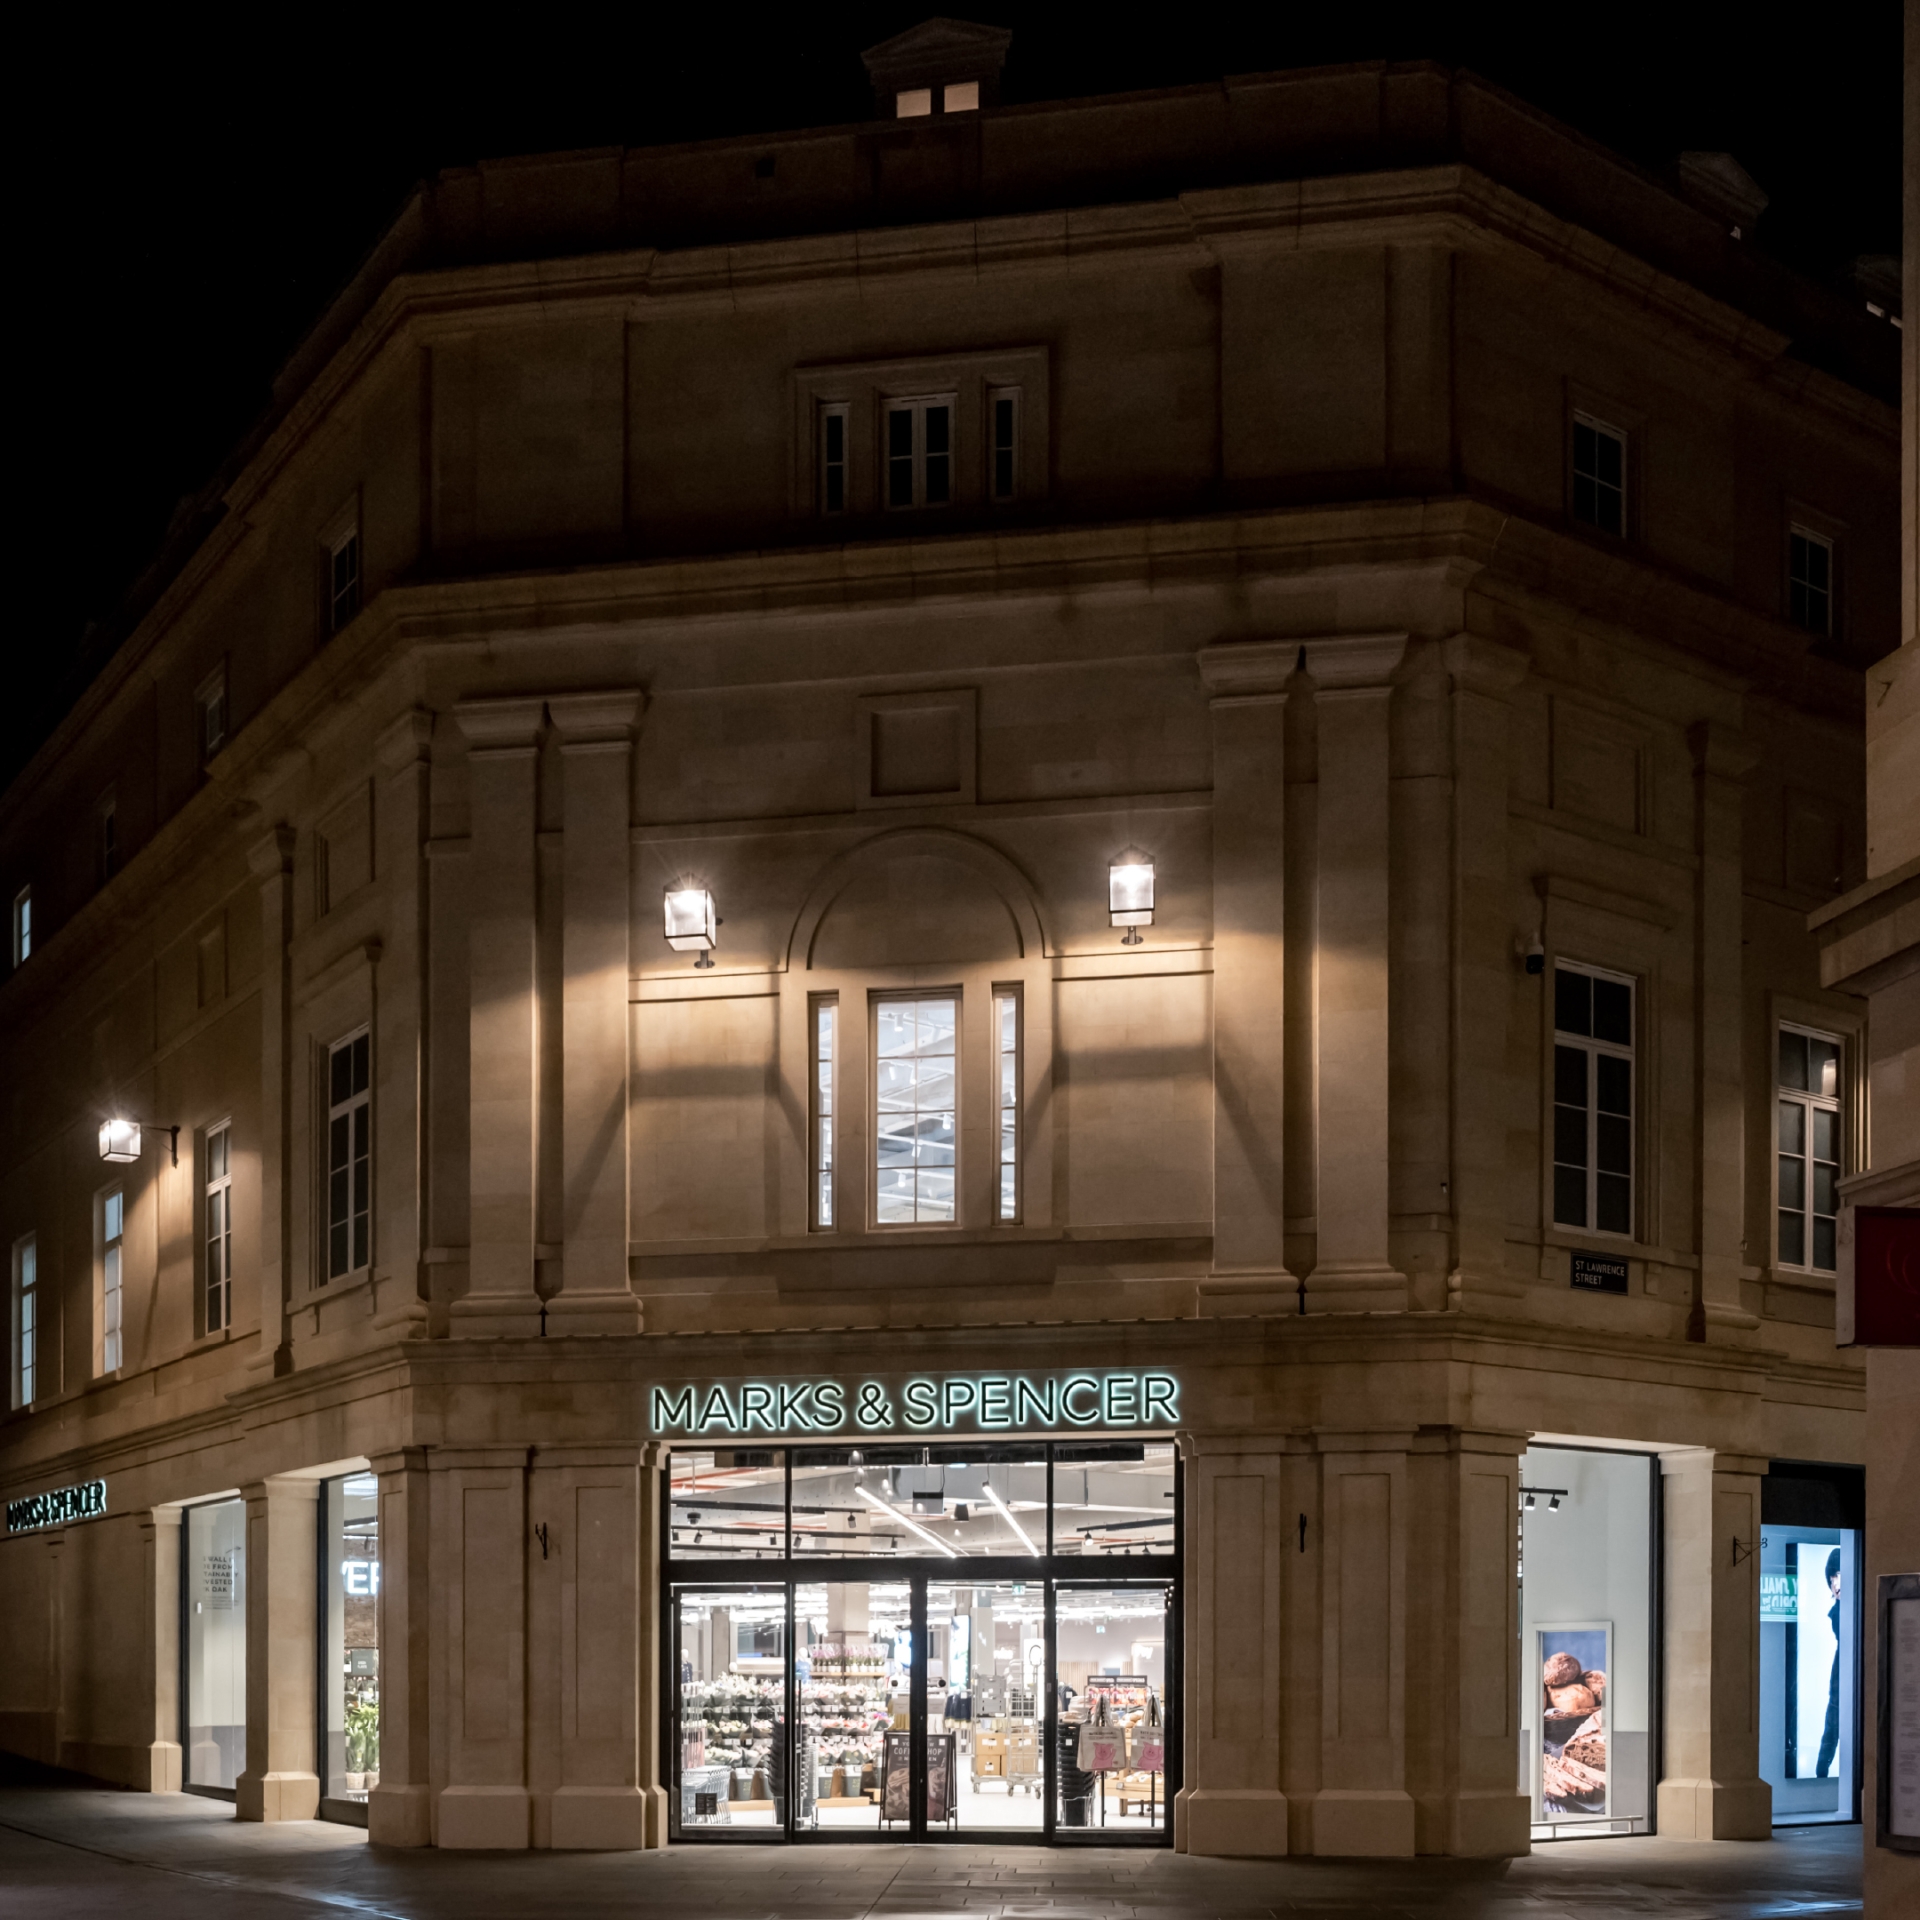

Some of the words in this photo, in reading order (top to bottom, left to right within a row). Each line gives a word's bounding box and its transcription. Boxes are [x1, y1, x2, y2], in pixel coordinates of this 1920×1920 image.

[1575, 1260, 1584, 1270] ST
[1586, 1262, 1625, 1277] LAWRENCE
[1575, 1273, 1602, 1285] STREET
[653, 1383, 843, 1431] MARKS
[857, 1382, 893, 1427] &
[903, 1376, 1178, 1428] SPENCER
